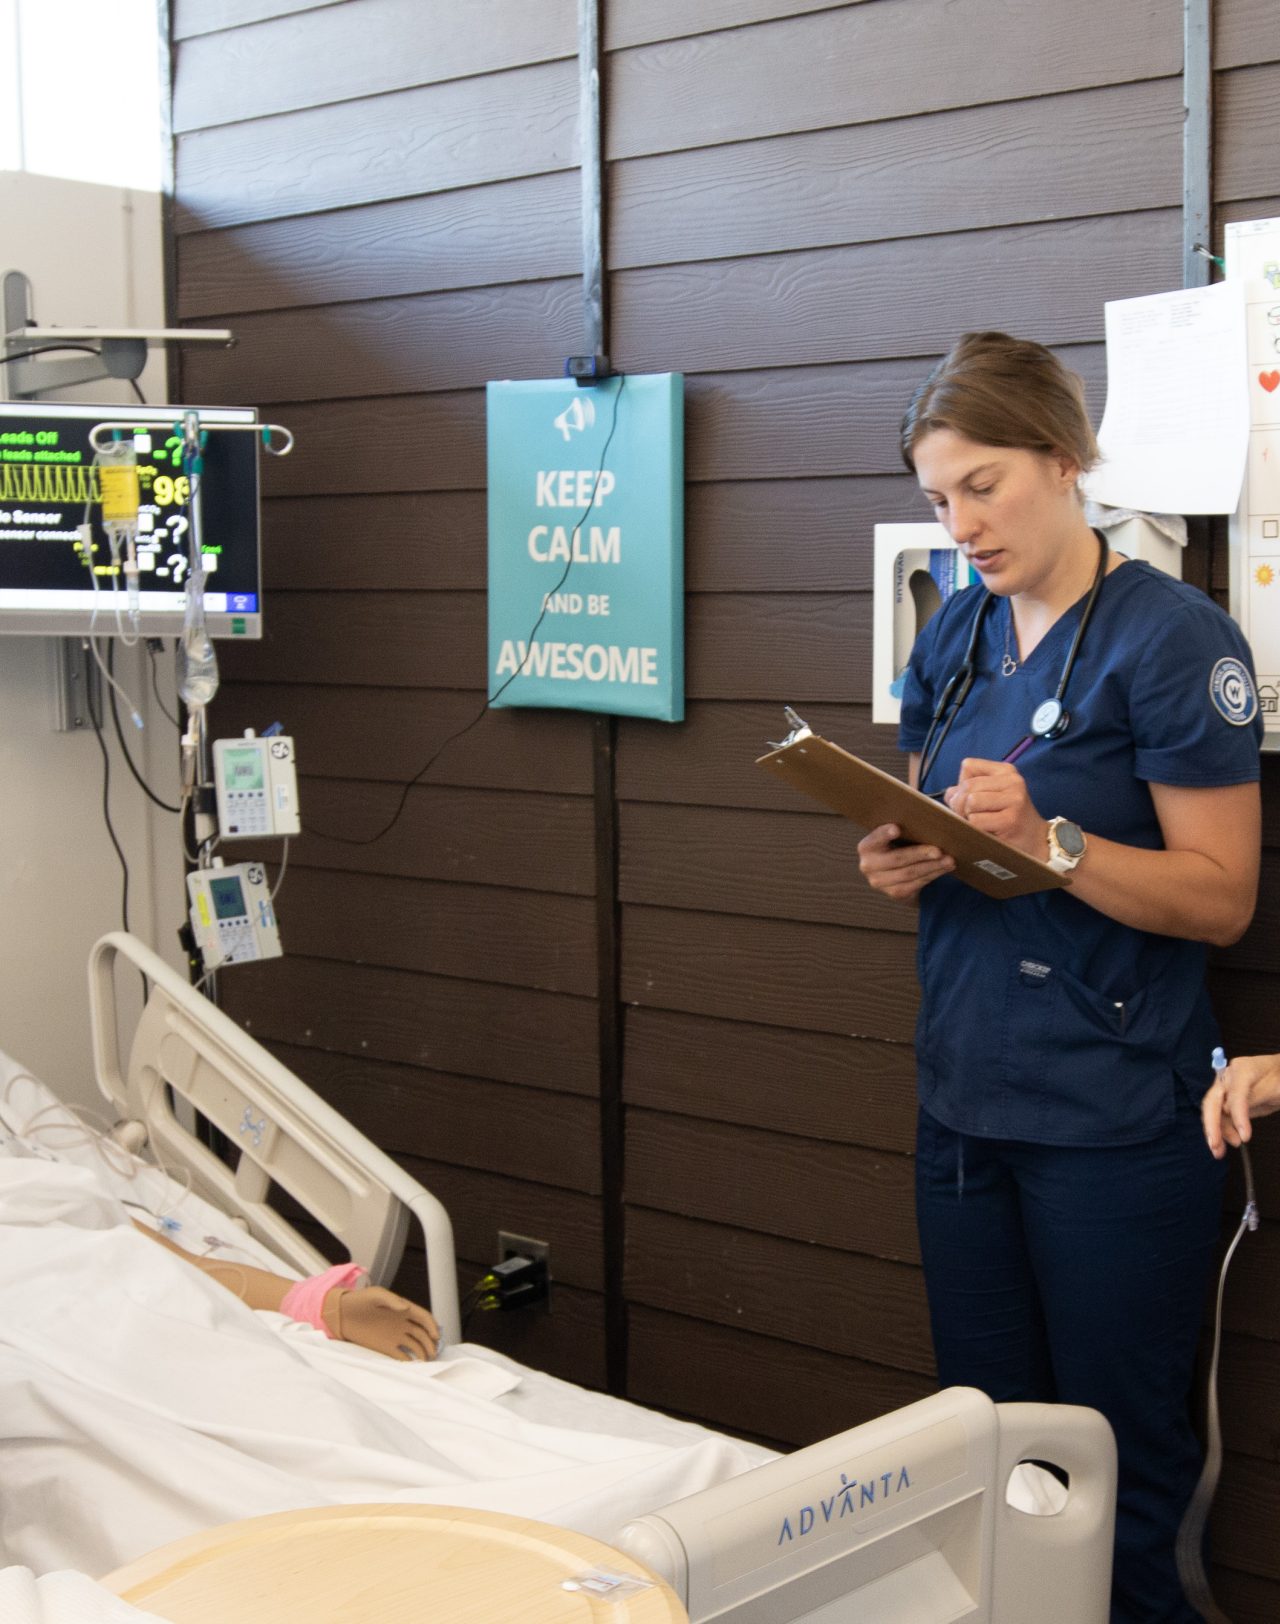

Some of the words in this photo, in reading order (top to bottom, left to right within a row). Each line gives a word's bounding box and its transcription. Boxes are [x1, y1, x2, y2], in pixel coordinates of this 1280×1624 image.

[0, 431, 34, 445] eads
[36, 431, 59, 446] Off
[536, 470, 616, 508] KEEP
[13, 509, 62, 524] Sensor
[528, 525, 622, 564] CALM
[540, 592, 583, 615] AND
[588, 594, 610, 616] BE
[496, 640, 658, 685] AWESOME
[777, 1465, 911, 1546] ADVANTA
